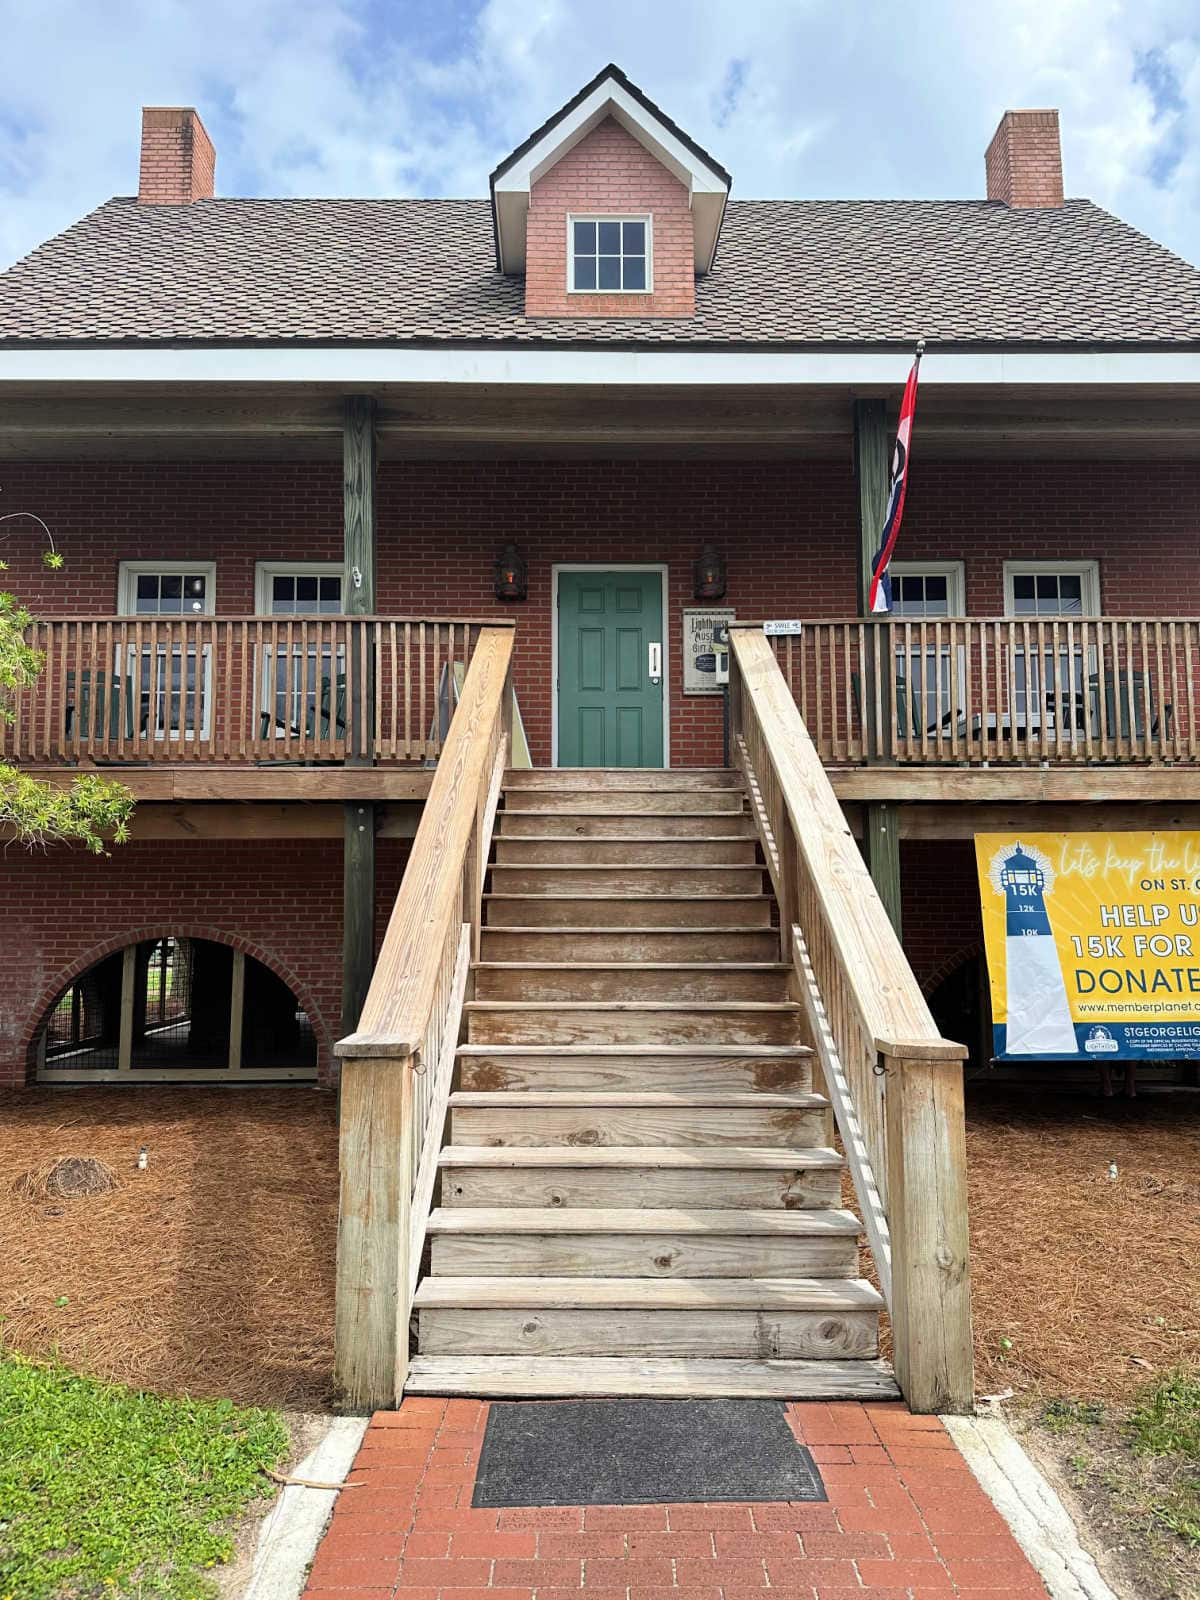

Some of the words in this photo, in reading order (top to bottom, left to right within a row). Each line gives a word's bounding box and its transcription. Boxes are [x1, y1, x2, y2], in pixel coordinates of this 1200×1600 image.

[1144, 841, 1181, 874] the
[1010, 884, 1038, 896] 15K
[1140, 879, 1165, 891] ON
[1170, 879, 1191, 891] ST.
[1018, 904, 1035, 912] 12K
[1099, 904, 1170, 927] HELP
[1179, 903, 1200, 926] U
[1021, 928, 1039, 936] 10K
[1071, 934, 1126, 958] 15K
[1133, 934, 1194, 957] FOR
[1075, 968, 1200, 994] DONATE
